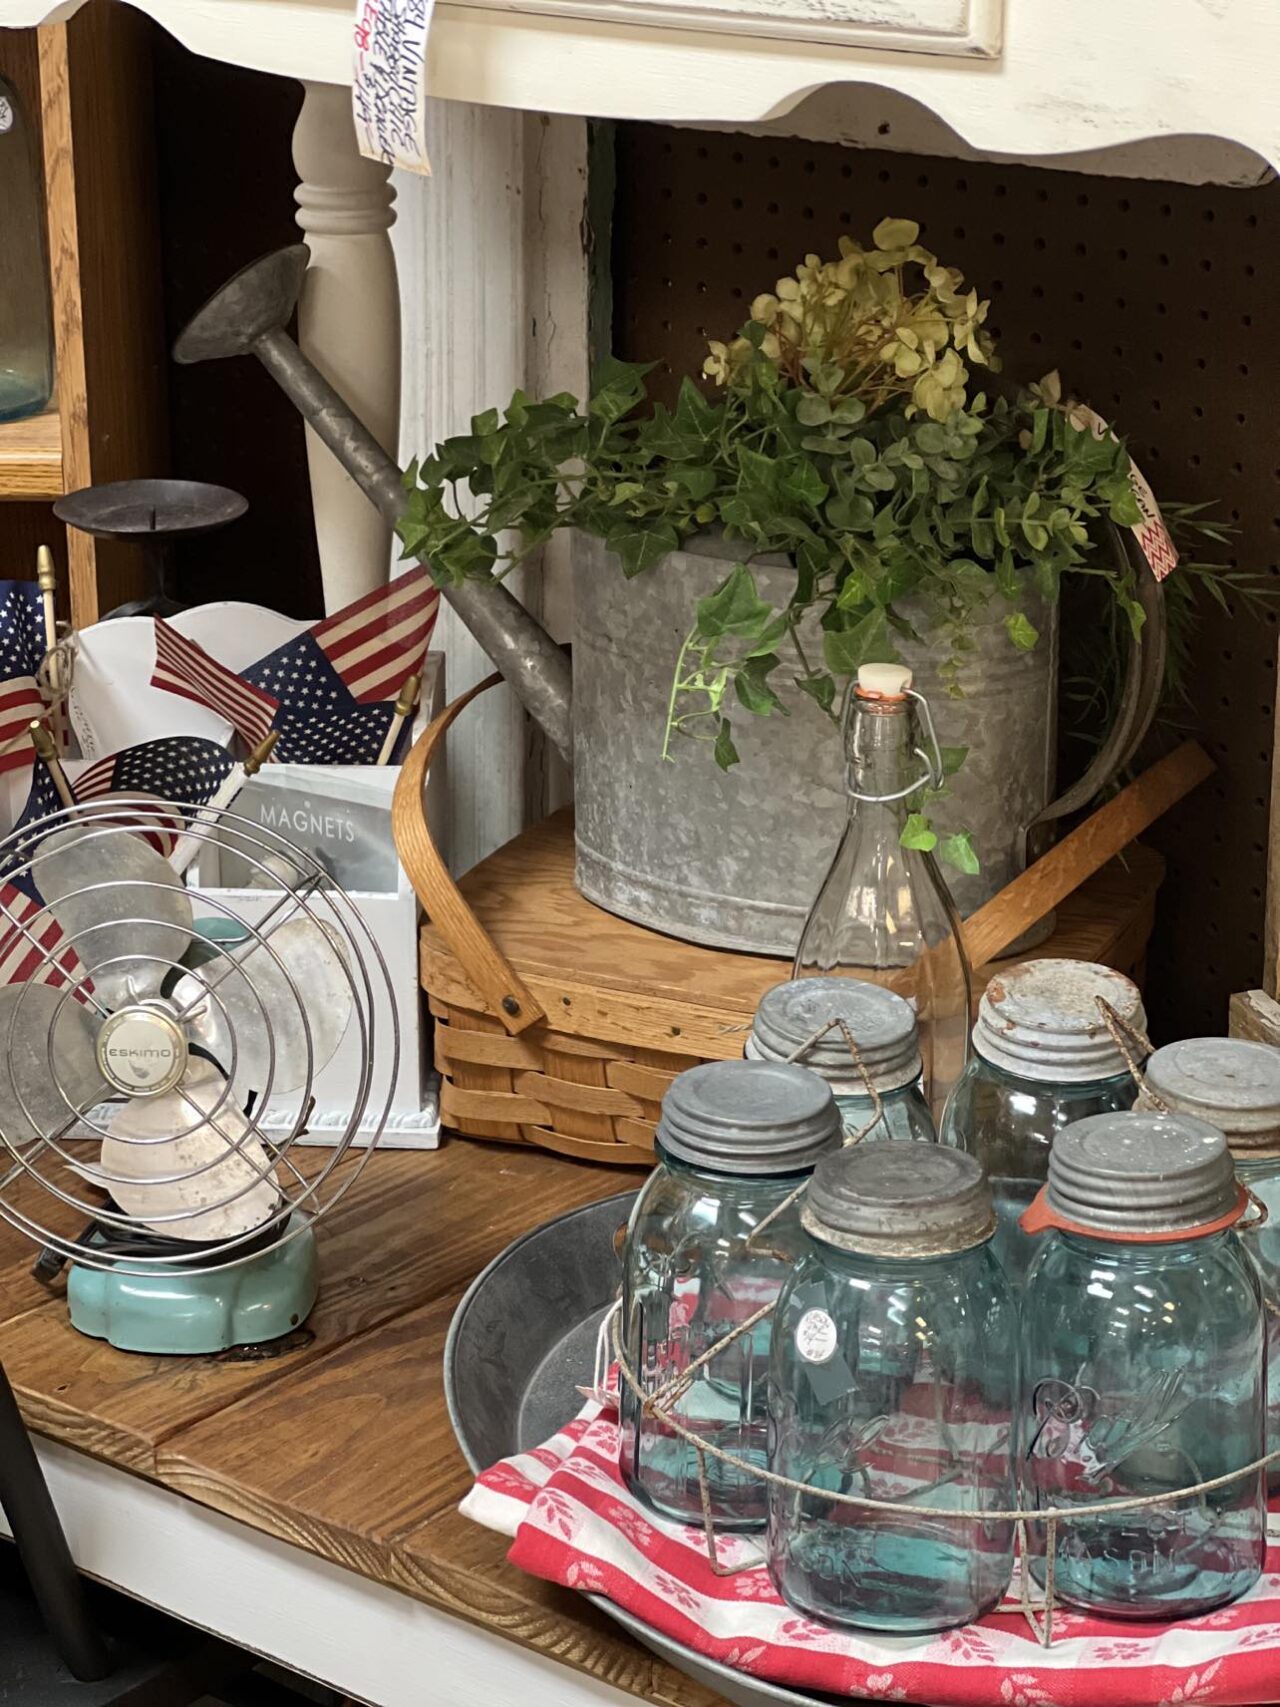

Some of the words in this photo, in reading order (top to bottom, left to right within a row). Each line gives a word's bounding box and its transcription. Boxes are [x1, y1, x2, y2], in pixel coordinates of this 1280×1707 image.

[398, 40, 425, 157] VINTAGE
[260, 803, 355, 842] MAGNETS
[108, 1048, 171, 1058] ESKIMO
